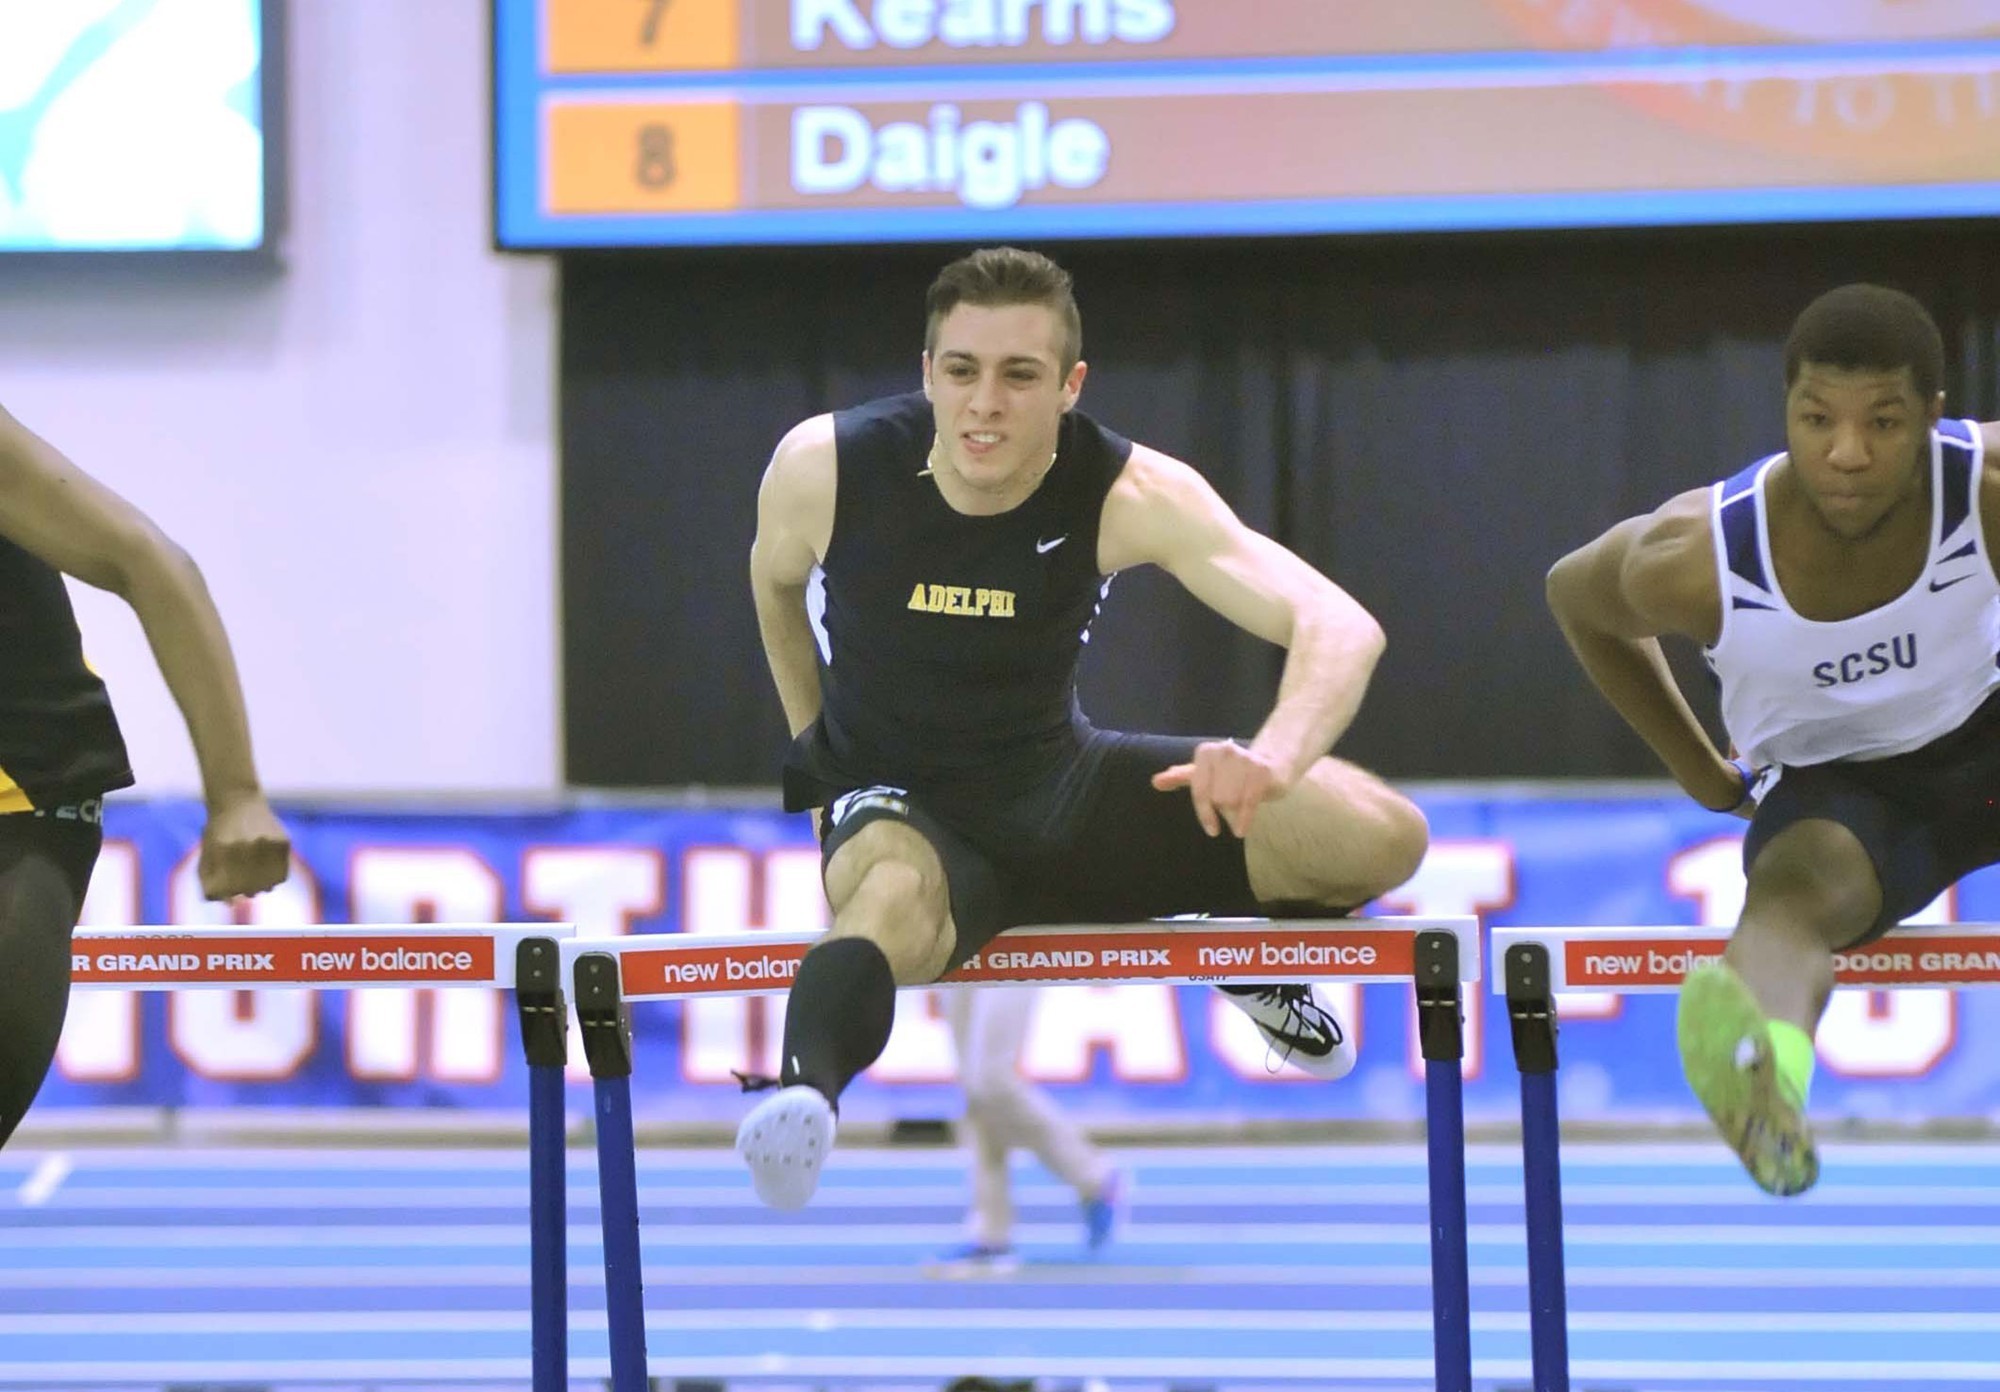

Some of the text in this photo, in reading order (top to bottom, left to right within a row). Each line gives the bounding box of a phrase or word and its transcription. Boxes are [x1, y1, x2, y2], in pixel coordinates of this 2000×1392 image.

[635, 101, 1110, 211] 8 Daigle
[908, 583, 1016, 617] ADELPHI
[1813, 632, 1918, 687] SCSU
[96, 954, 200, 971] GRAND
[206, 953, 274, 971] PRIX
[301, 951, 355, 971] new
[361, 947, 472, 971] balance
[664, 955, 802, 983] new balan
[987, 950, 1094, 969] GRAND
[1101, 949, 1171, 966] PRIX
[1198, 947, 1254, 966] new
[1260, 942, 1377, 966] balance
[1585, 955, 1642, 975] new
[1832, 952, 2000, 971] DOOR GRAN
